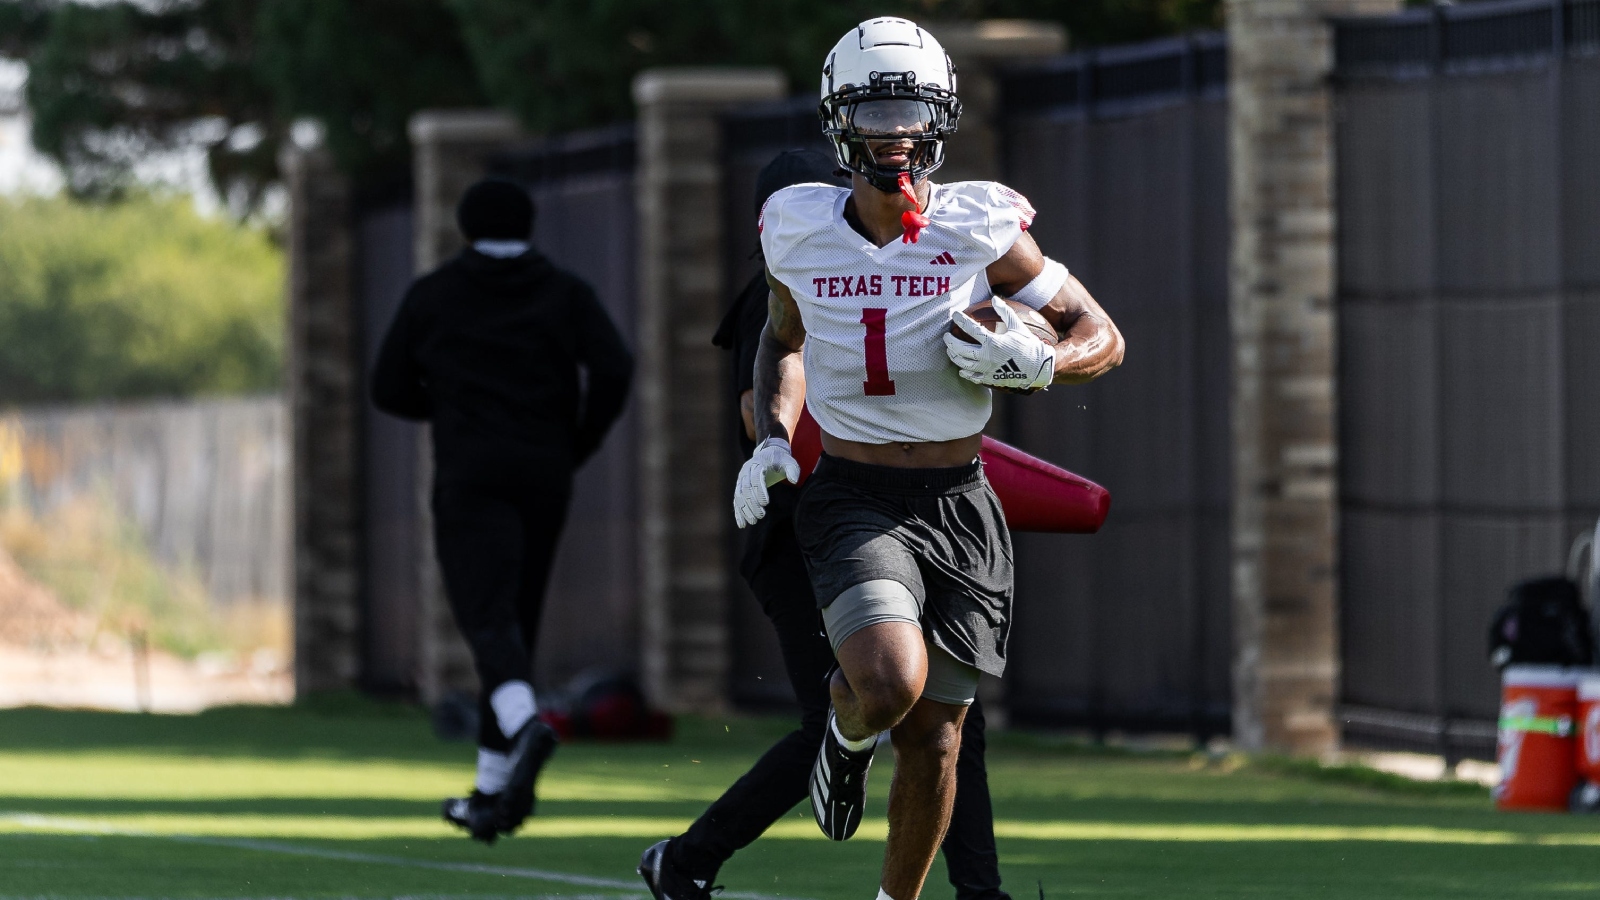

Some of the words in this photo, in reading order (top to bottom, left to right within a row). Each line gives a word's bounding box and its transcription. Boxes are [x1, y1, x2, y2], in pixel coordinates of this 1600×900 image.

[812, 275, 883, 298] TEXAS
[890, 275, 951, 297] TECH
[860, 308, 896, 396] 1
[992, 371, 1028, 380] adidas
